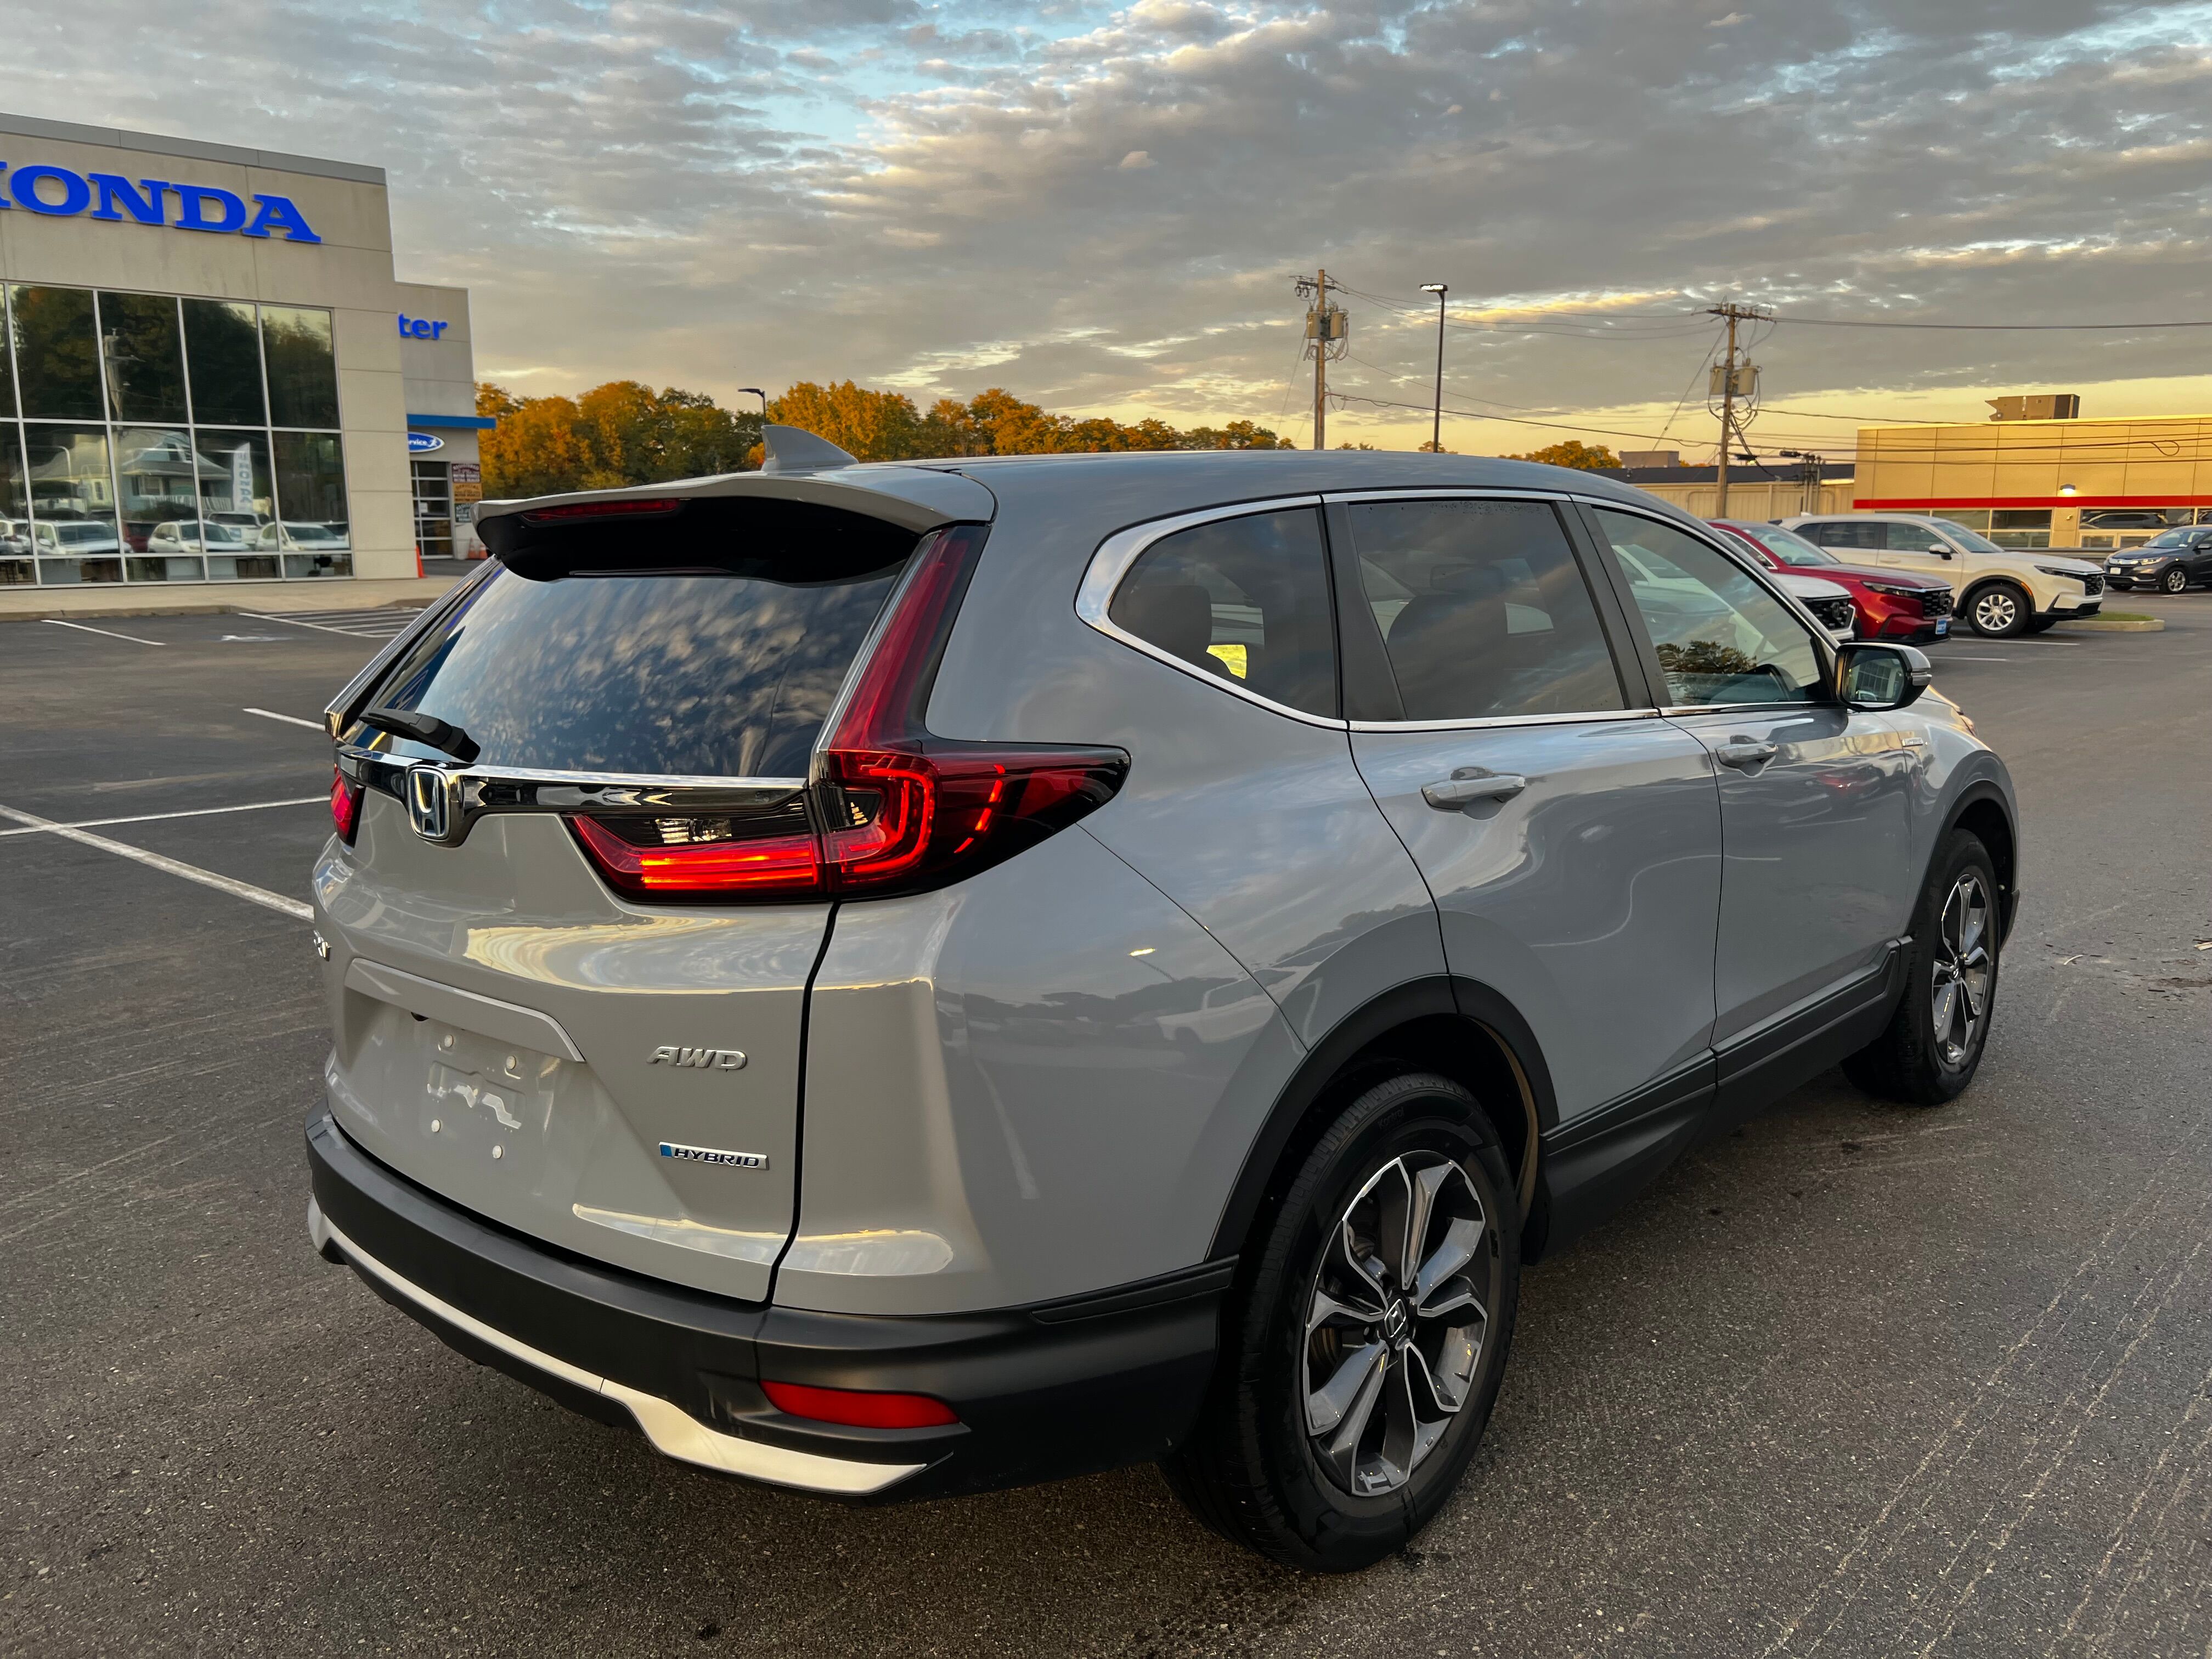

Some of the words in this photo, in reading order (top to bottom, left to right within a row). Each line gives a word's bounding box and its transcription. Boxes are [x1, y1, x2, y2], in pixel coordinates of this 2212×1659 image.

[0, 161, 321, 243] ONDA
[398, 313, 448, 340] ter
[647, 1046, 747, 1070] AWD
[674, 1148, 759, 1168] HYBRID
